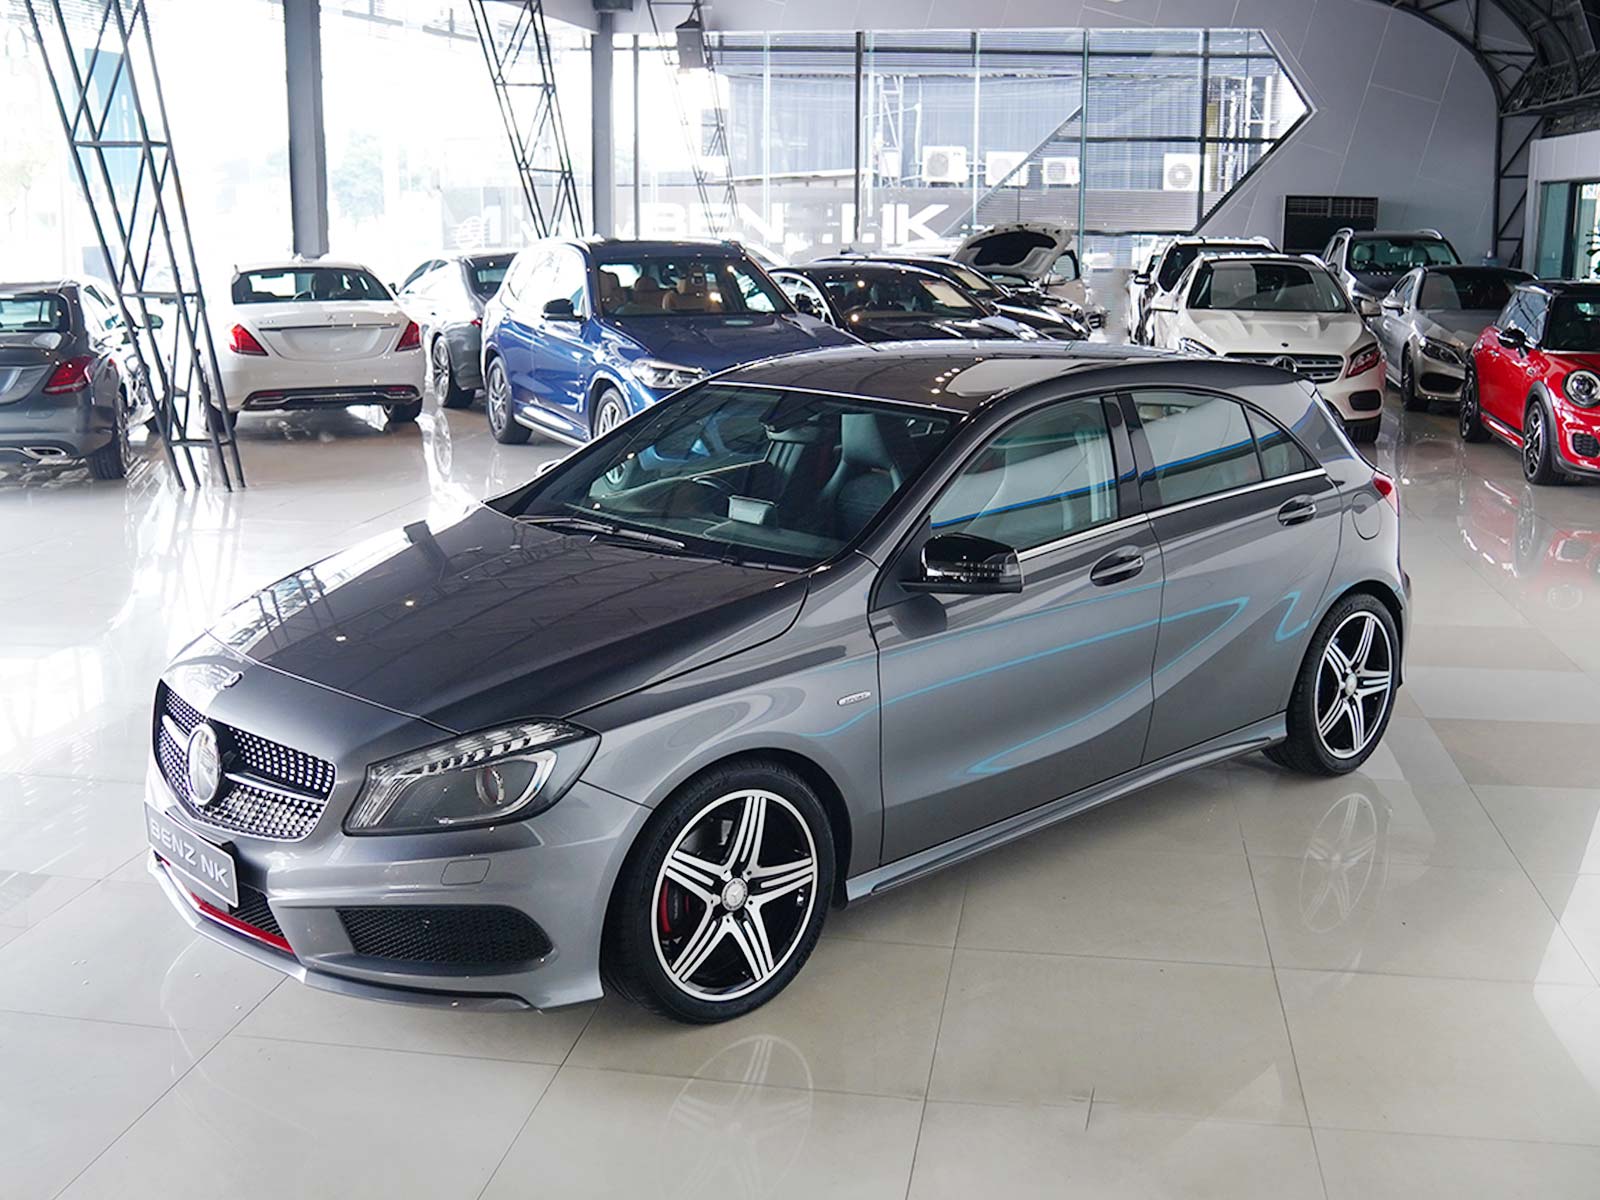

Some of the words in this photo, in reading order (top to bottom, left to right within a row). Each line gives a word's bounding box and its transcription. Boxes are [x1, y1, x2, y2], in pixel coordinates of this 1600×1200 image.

[642, 202, 833, 244] BEN
[151, 819, 197, 866] BENZ
[200, 853, 229, 889] NK
